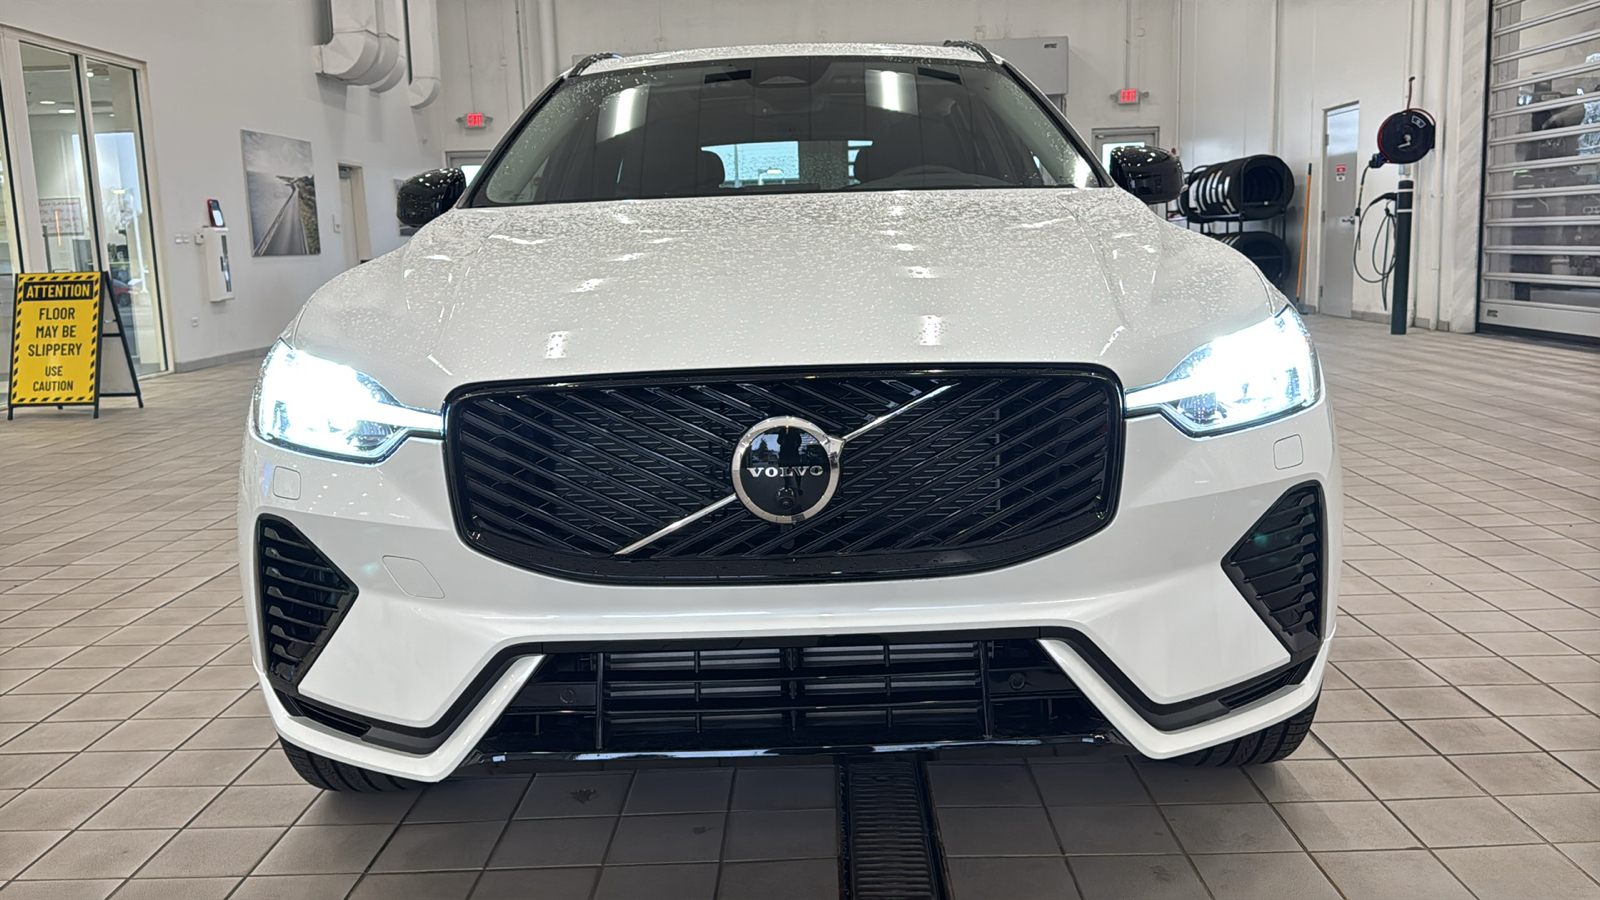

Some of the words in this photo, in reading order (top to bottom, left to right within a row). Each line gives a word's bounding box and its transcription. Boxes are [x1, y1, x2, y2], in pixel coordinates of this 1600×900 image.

[467, 113, 482, 126] EXIT
[26, 283, 90, 298] ATTENTION
[39, 307, 75, 320] FLOOR
[36, 325, 58, 338] MAY
[62, 325, 77, 338] BE
[28, 343, 82, 357] SLIPPERY
[45, 366, 63, 377] USE
[33, 380, 74, 392] CAUTION
[747, 465, 824, 478] VOLVO
